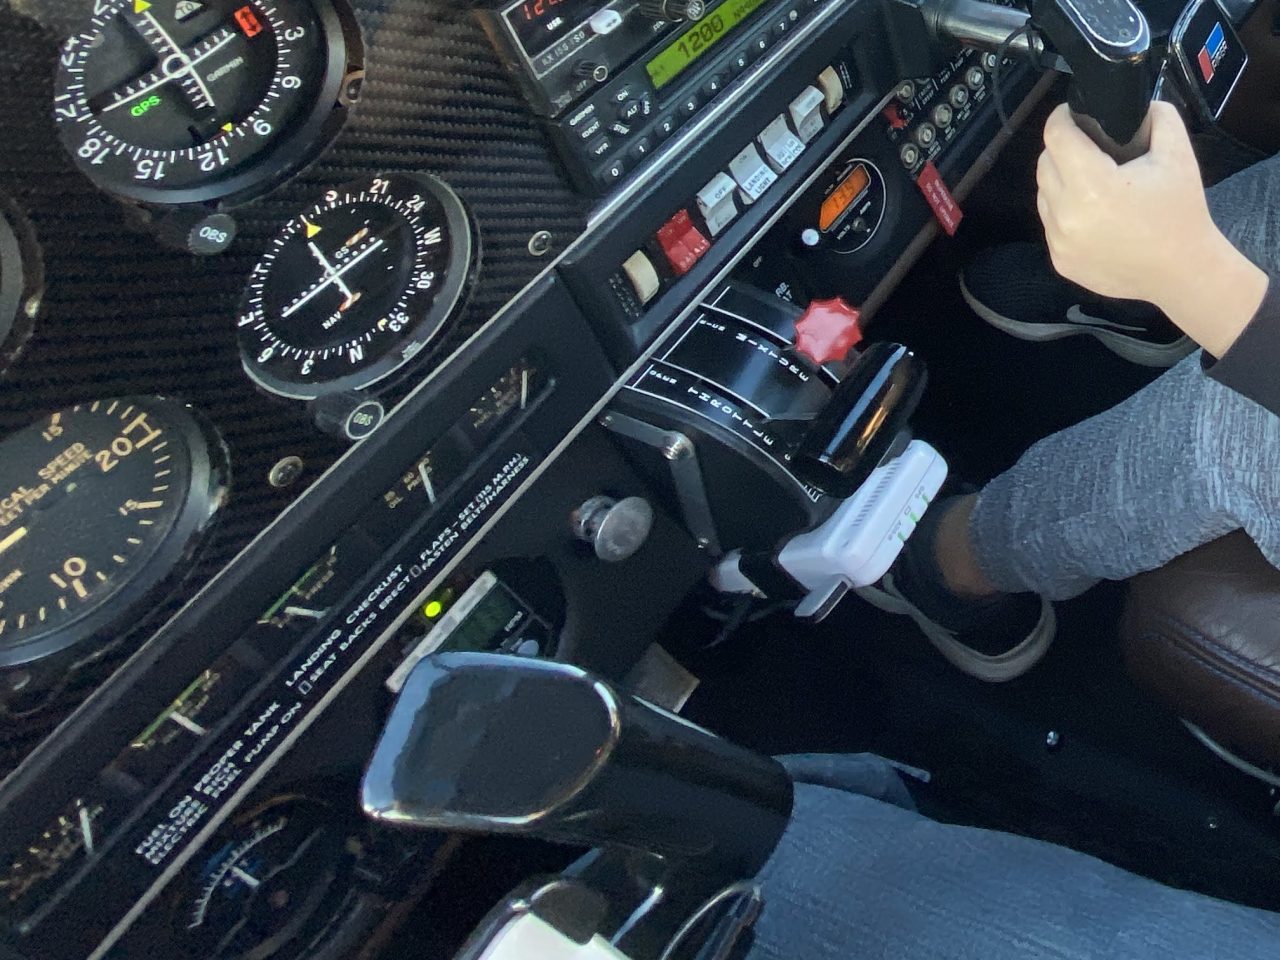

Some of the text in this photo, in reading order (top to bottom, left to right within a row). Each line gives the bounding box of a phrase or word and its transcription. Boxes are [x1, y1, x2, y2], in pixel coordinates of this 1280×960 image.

[546, 17, 562, 31] USE
[779, 22, 785, 31] 7
[284, 26, 305, 41] 3
[677, 15, 724, 59] 1200
[759, 40, 766, 49] 6
[206, 56, 244, 82] GARMIN
[738, 58, 745, 67] 5
[281, 75, 302, 89] 6
[711, 82, 717, 90] 4
[617, 90, 630, 102] ON
[130, 95, 162, 117] GPS
[569, 103, 595, 127] GARMIN
[627, 104, 640, 117] ALT
[688, 102, 695, 111] 3
[253, 119, 272, 136] 9
[581, 121, 600, 139] IDENT
[663, 122, 671, 132] 2
[77, 138, 110, 165] 18
[594, 142, 609, 156] VFR
[639, 144, 646, 153] 1
[197, 148, 229, 172] 12
[134, 160, 166, 181] 15
[611, 168, 619, 177] 0
[745, 166, 769, 191] LANDING
[370, 179, 389, 194] 21
[715, 186, 727, 199] OFF
[754, 178, 772, 194] LIGHT
[406, 194, 425, 213] 24
[200, 226, 227, 243] OBS
[424, 227, 442, 245] W
[335, 246, 350, 259] GS
[417, 271, 435, 289] 30
[322, 311, 343, 330] NAV
[388, 311, 410, 332] 33
[349, 347, 364, 364] N
[735, 332, 810, 382] MIXTURE
[301, 359, 314, 375] 3
[353, 411, 374, 427] OBS
[687, 386, 774, 446] THROTTLE
[38, 442, 85, 480] SPEED
[94, 436, 133, 473] 20
[421, 455, 530, 571] FASTEN BELTS/HARNESS
[419, 526, 452, 561] FLAPS
[458, 501, 476, 521] SET
[50, 556, 87, 589] 10
[285, 628, 342, 687] LANDING
[345, 563, 403, 625] CHECKLIST
[309, 652, 337, 683] SEAT
[339, 611, 378, 652] BACKS
[378, 575, 410, 610] ERECT
[243, 724, 280, 763] PUMP
[280, 701, 302, 725] ON
[168, 795, 193, 819] ON
[193, 740, 244, 792] PROPER
[243, 701, 281, 736] TANK
